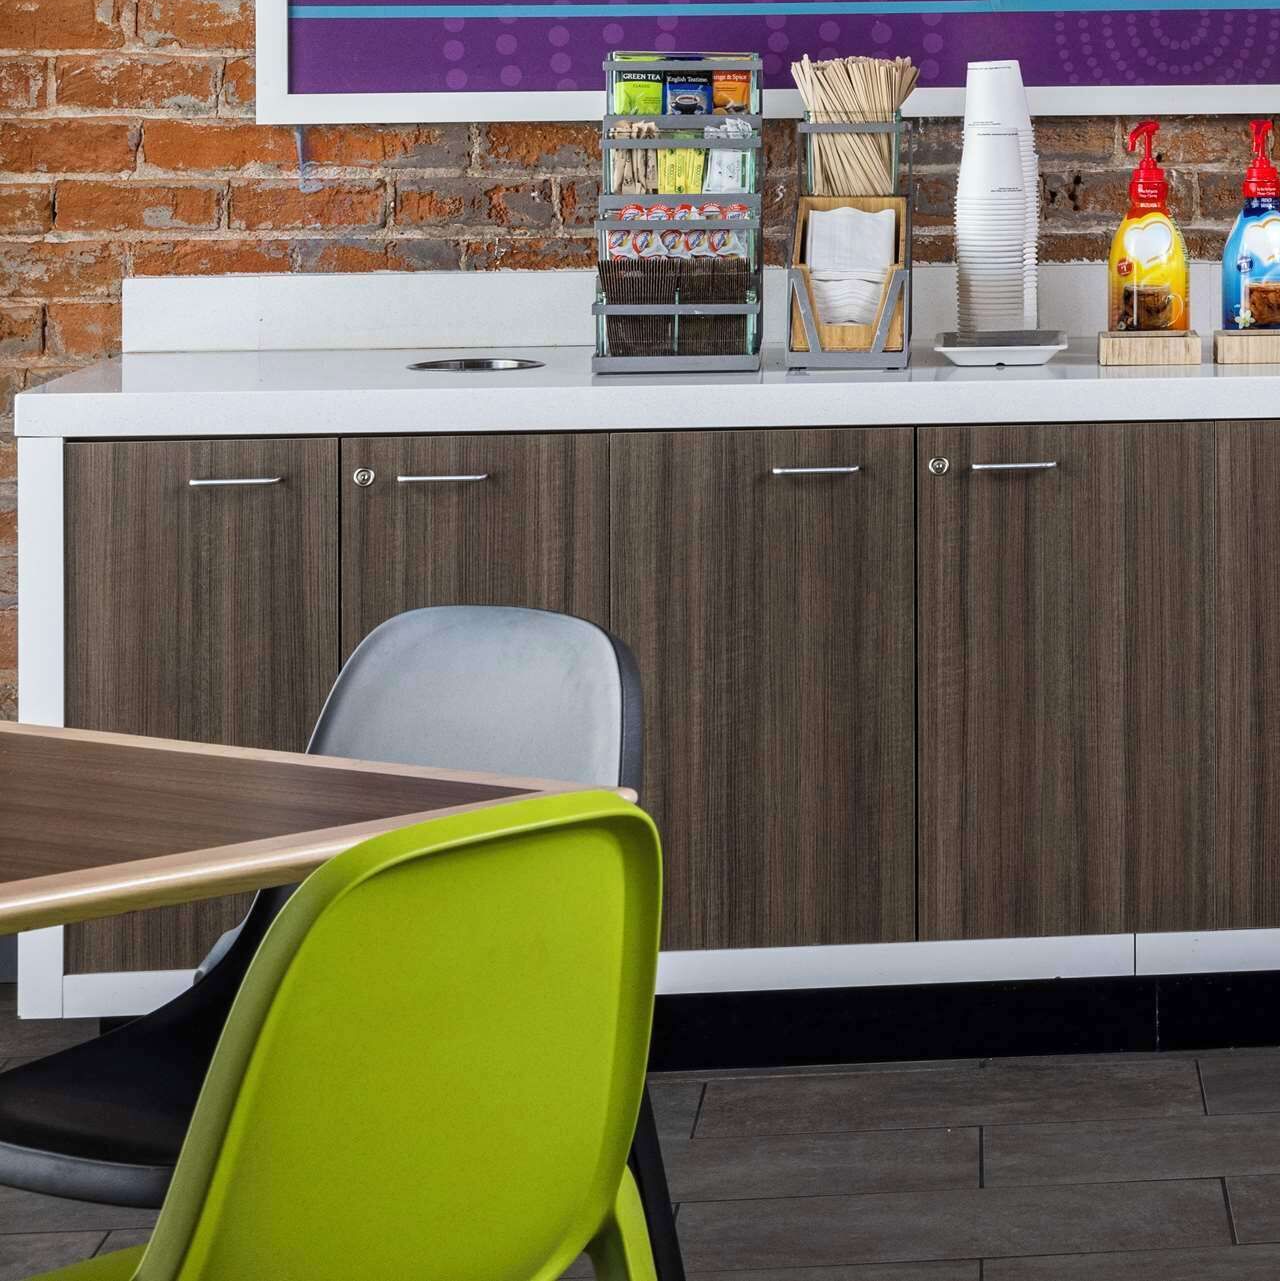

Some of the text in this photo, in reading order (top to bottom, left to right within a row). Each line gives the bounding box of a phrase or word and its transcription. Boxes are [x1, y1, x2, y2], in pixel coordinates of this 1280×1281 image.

[647, 73, 661, 81] TEA
[666, 75, 686, 83] English
[732, 73, 747, 81] Spice
